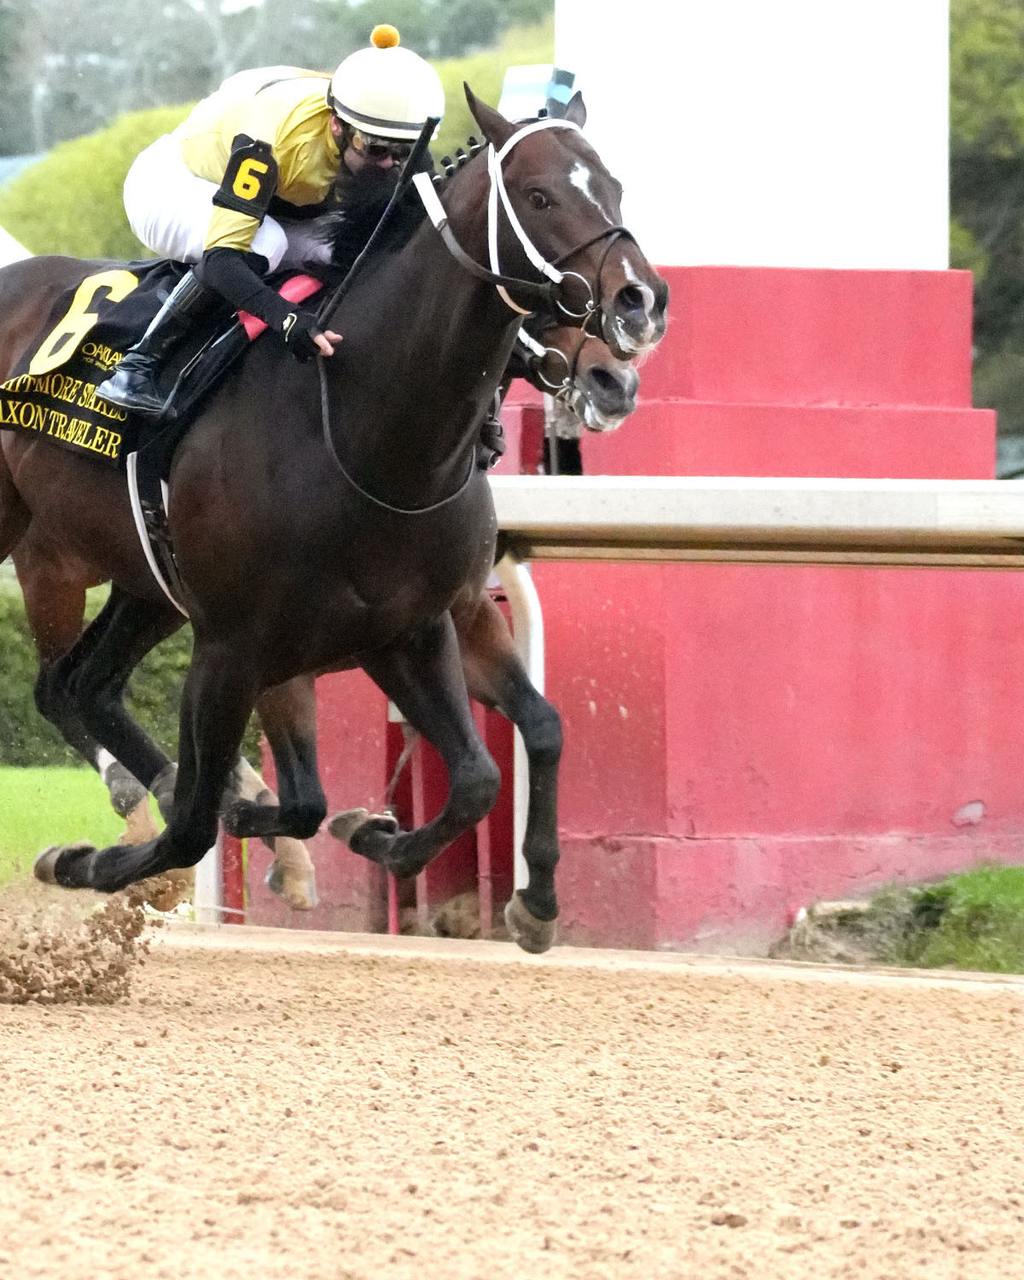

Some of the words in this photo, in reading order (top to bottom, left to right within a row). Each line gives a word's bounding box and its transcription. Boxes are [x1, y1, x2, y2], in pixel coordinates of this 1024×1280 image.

[232, 158, 269, 201] 6
[29, 270, 139, 376] 6
[82, 342, 123, 366] OAKLA
[47, 410, 122, 459] TRAVELER
